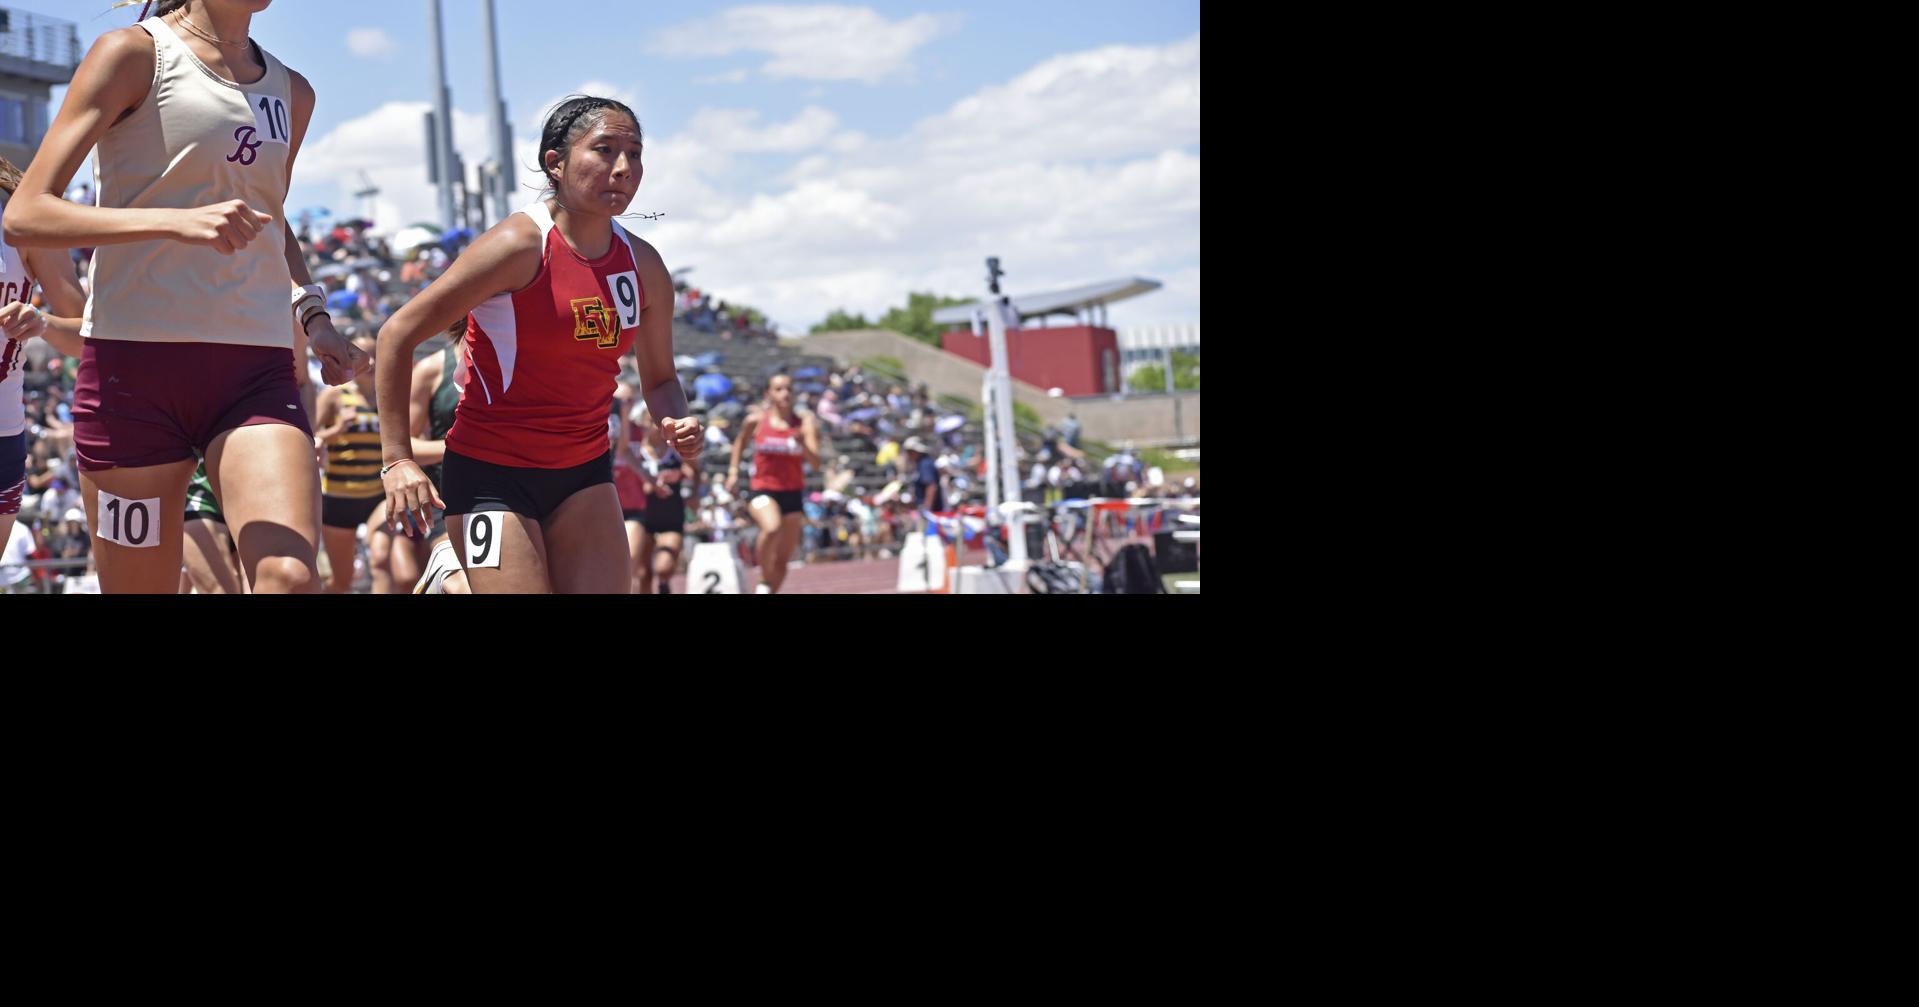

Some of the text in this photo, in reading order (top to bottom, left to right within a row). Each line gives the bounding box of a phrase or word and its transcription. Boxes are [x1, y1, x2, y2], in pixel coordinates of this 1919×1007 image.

[259, 97, 288, 143] 10
[226, 125, 263, 166] B
[570, 296, 621, 350] EV
[616, 275, 637, 325] 9
[106, 498, 150, 545] 10
[469, 514, 493, 565] 9
[703, 571, 721, 594] 2
